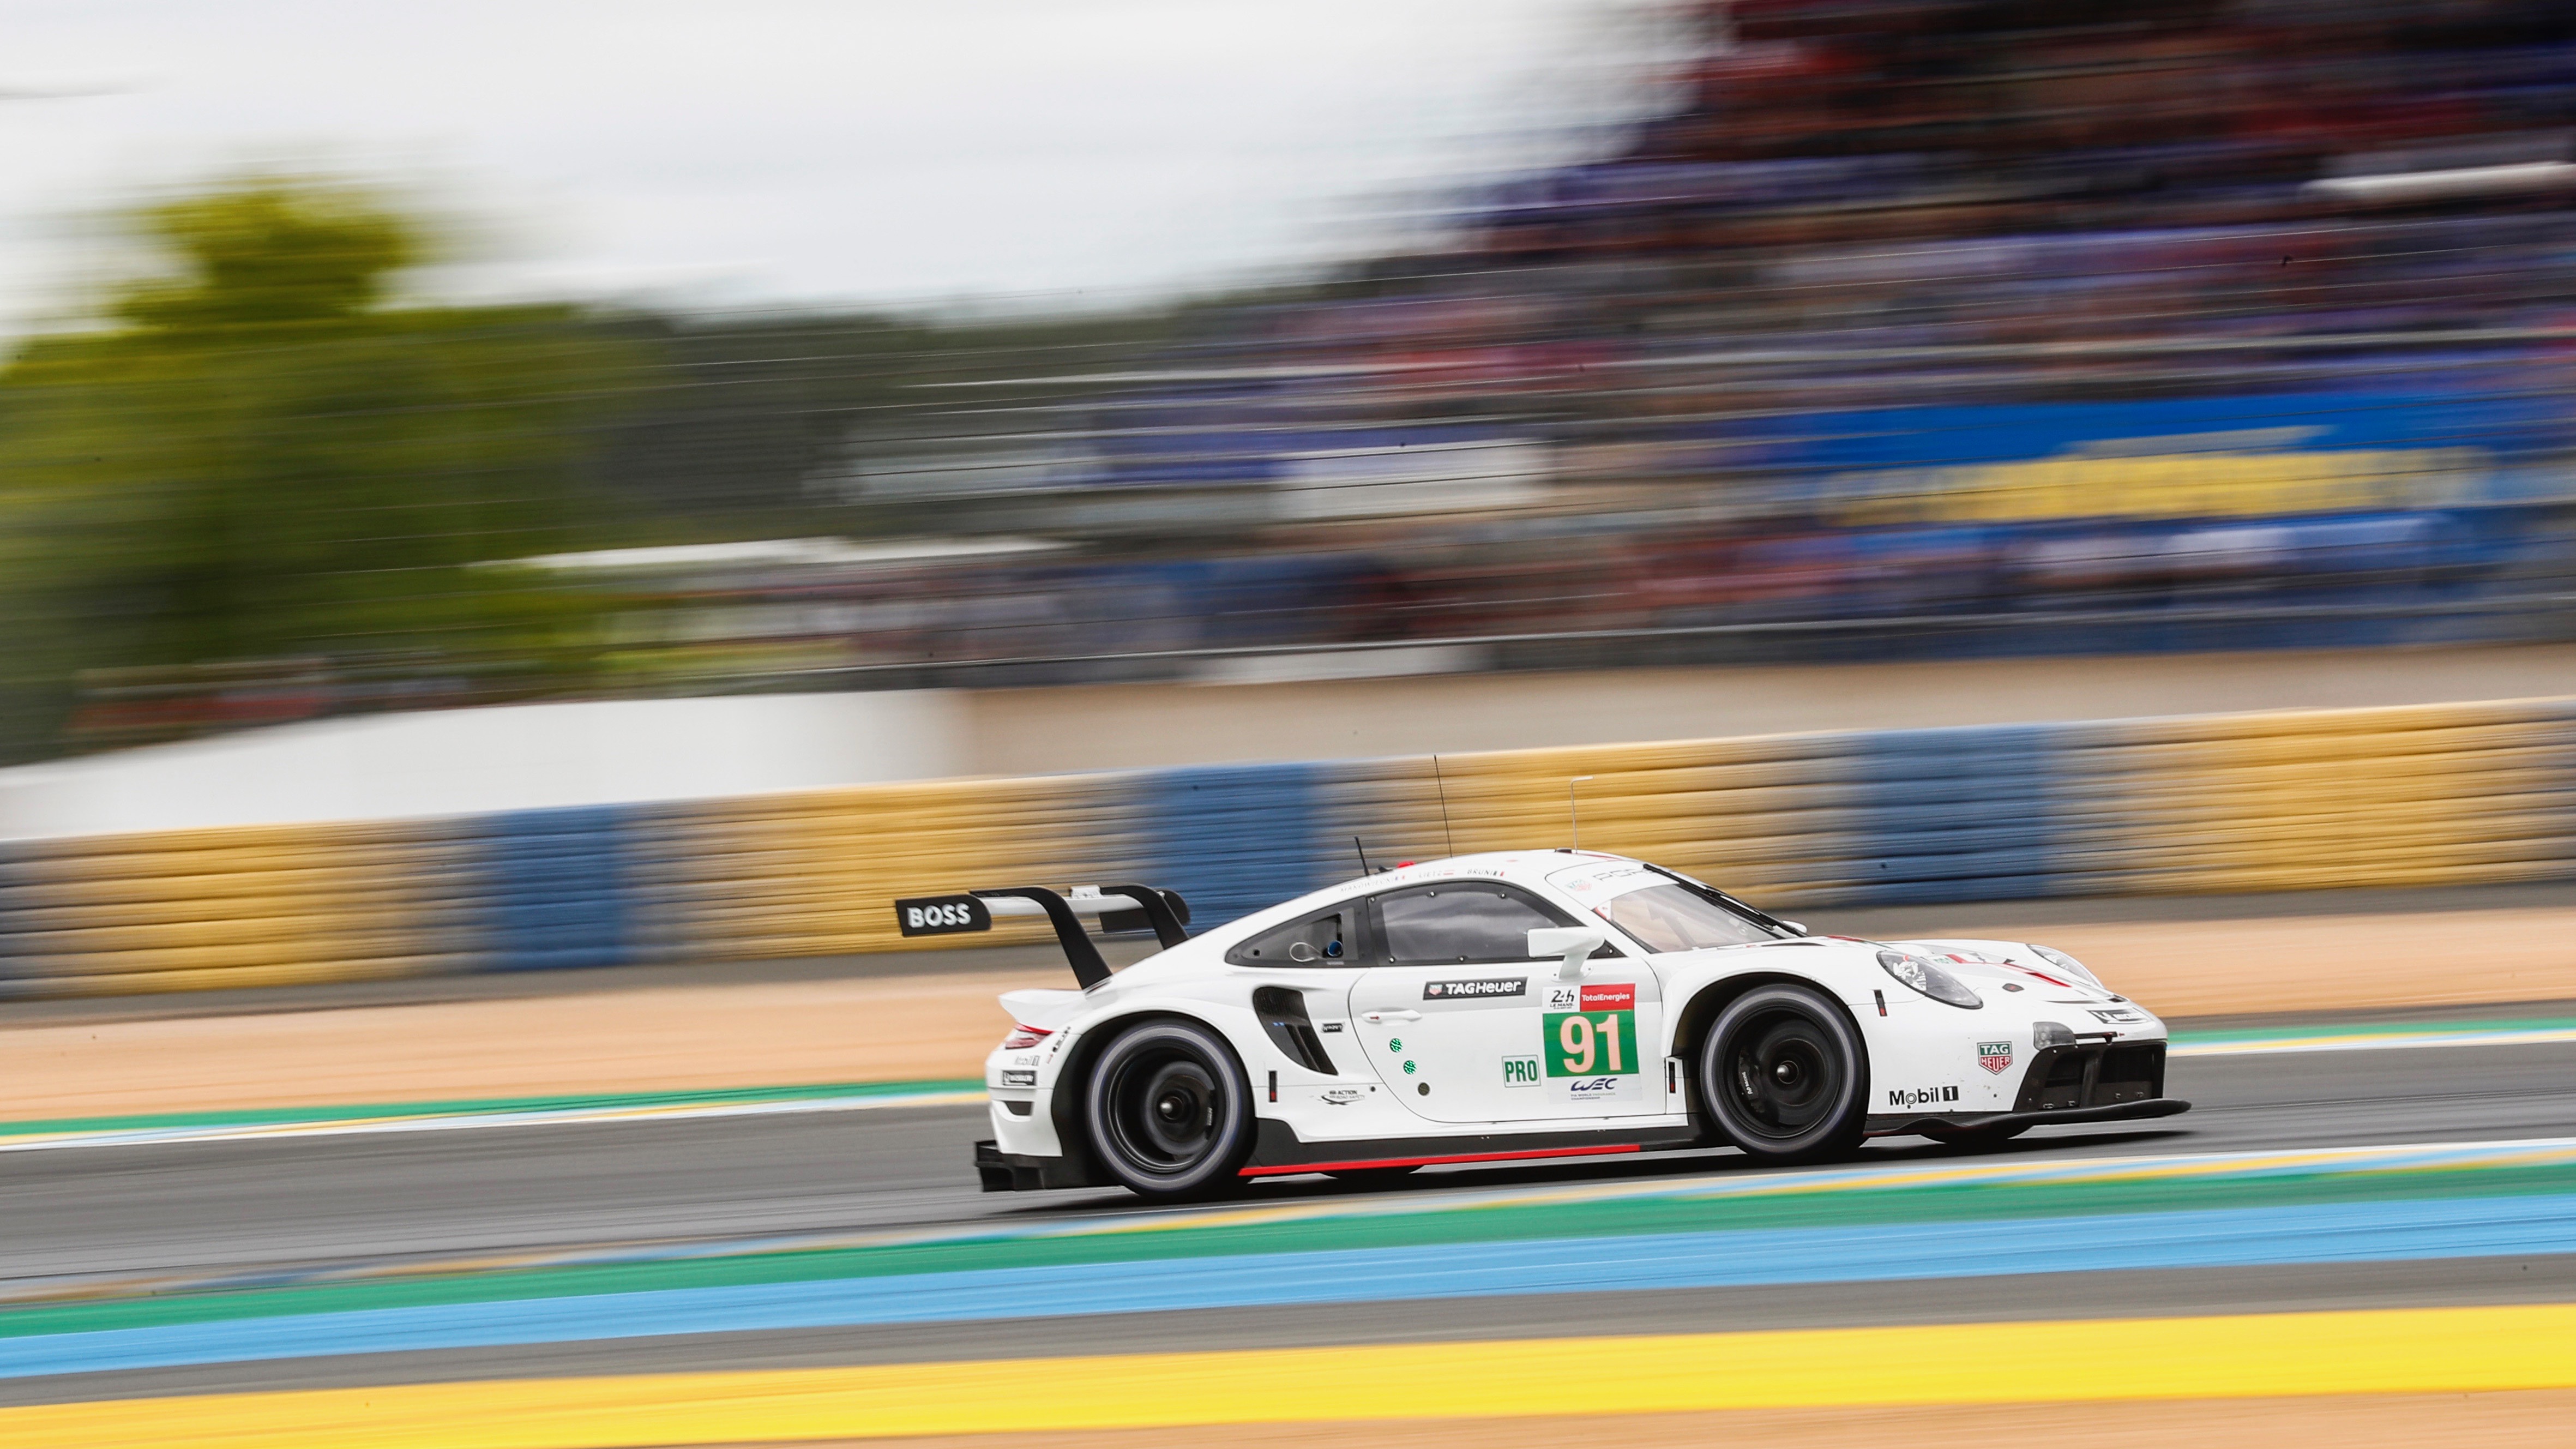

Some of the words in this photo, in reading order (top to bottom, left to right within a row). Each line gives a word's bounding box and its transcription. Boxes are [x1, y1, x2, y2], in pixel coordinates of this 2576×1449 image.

[907, 903, 971, 928] BOSS
[1581, 993, 1630, 1002] TotalEnergies
[1560, 1014, 1622, 1073] 91
[1981, 1044, 2009, 1055] TAG
[1504, 1060, 1538, 1083] PRO
[1981, 1056, 2010, 1072] HEUER
[1570, 1078, 1618, 1091] WEC
[1889, 1087, 1939, 1105] Mobil
[1945, 1087, 1955, 1101] 1
